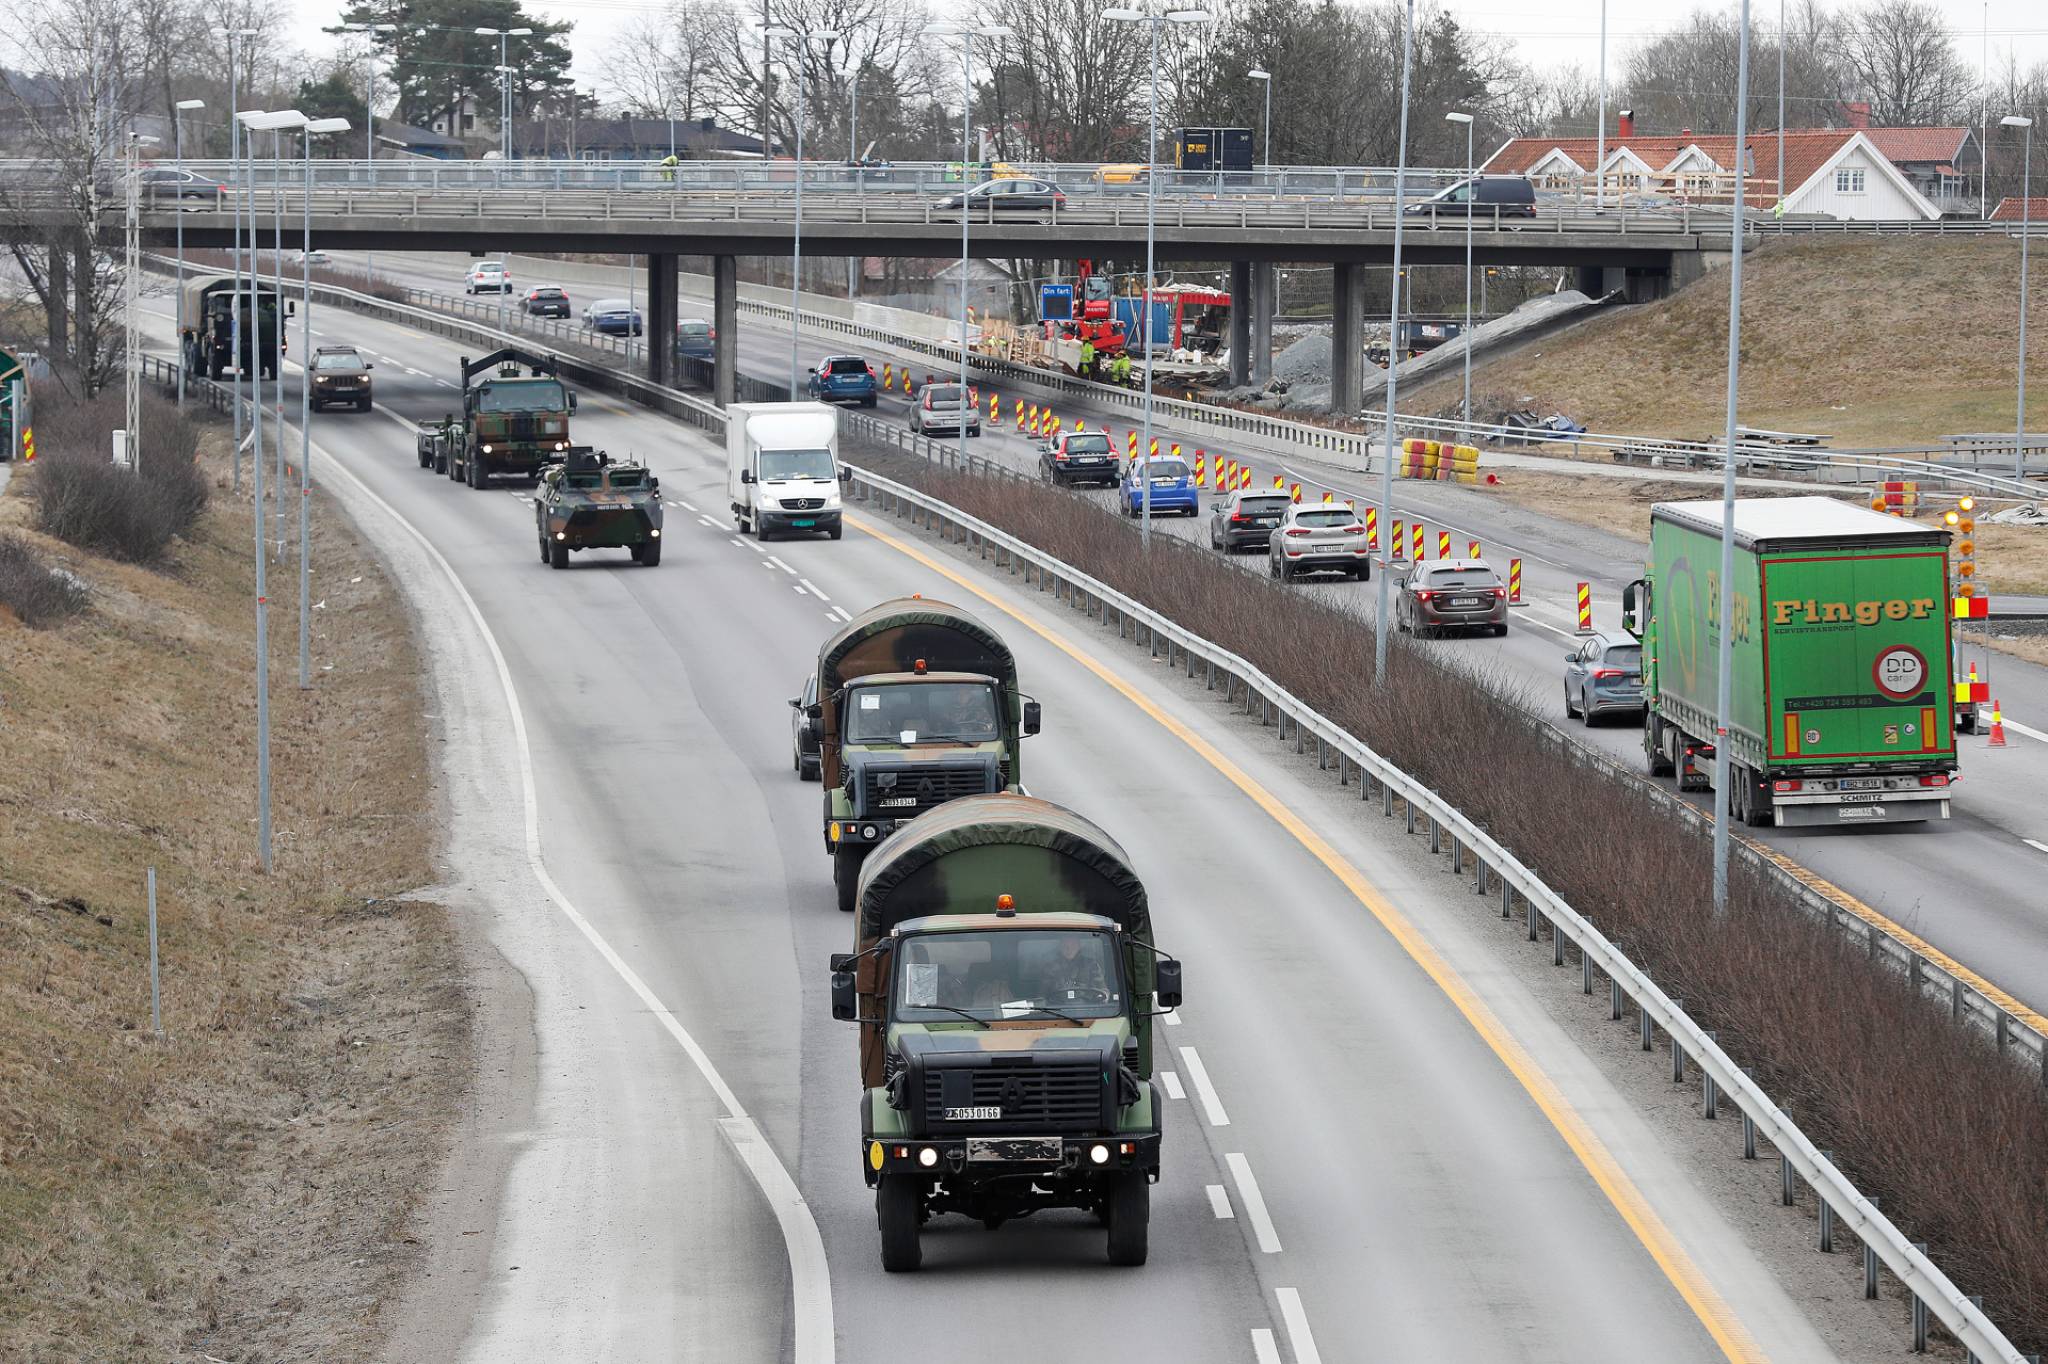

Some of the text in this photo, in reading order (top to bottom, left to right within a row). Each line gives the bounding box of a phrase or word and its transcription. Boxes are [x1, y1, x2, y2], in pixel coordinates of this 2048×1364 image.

[1772, 598, 1937, 627] Finger
[1886, 658, 1917, 673] DD
[1840, 794, 1883, 802] SCHMITZ
